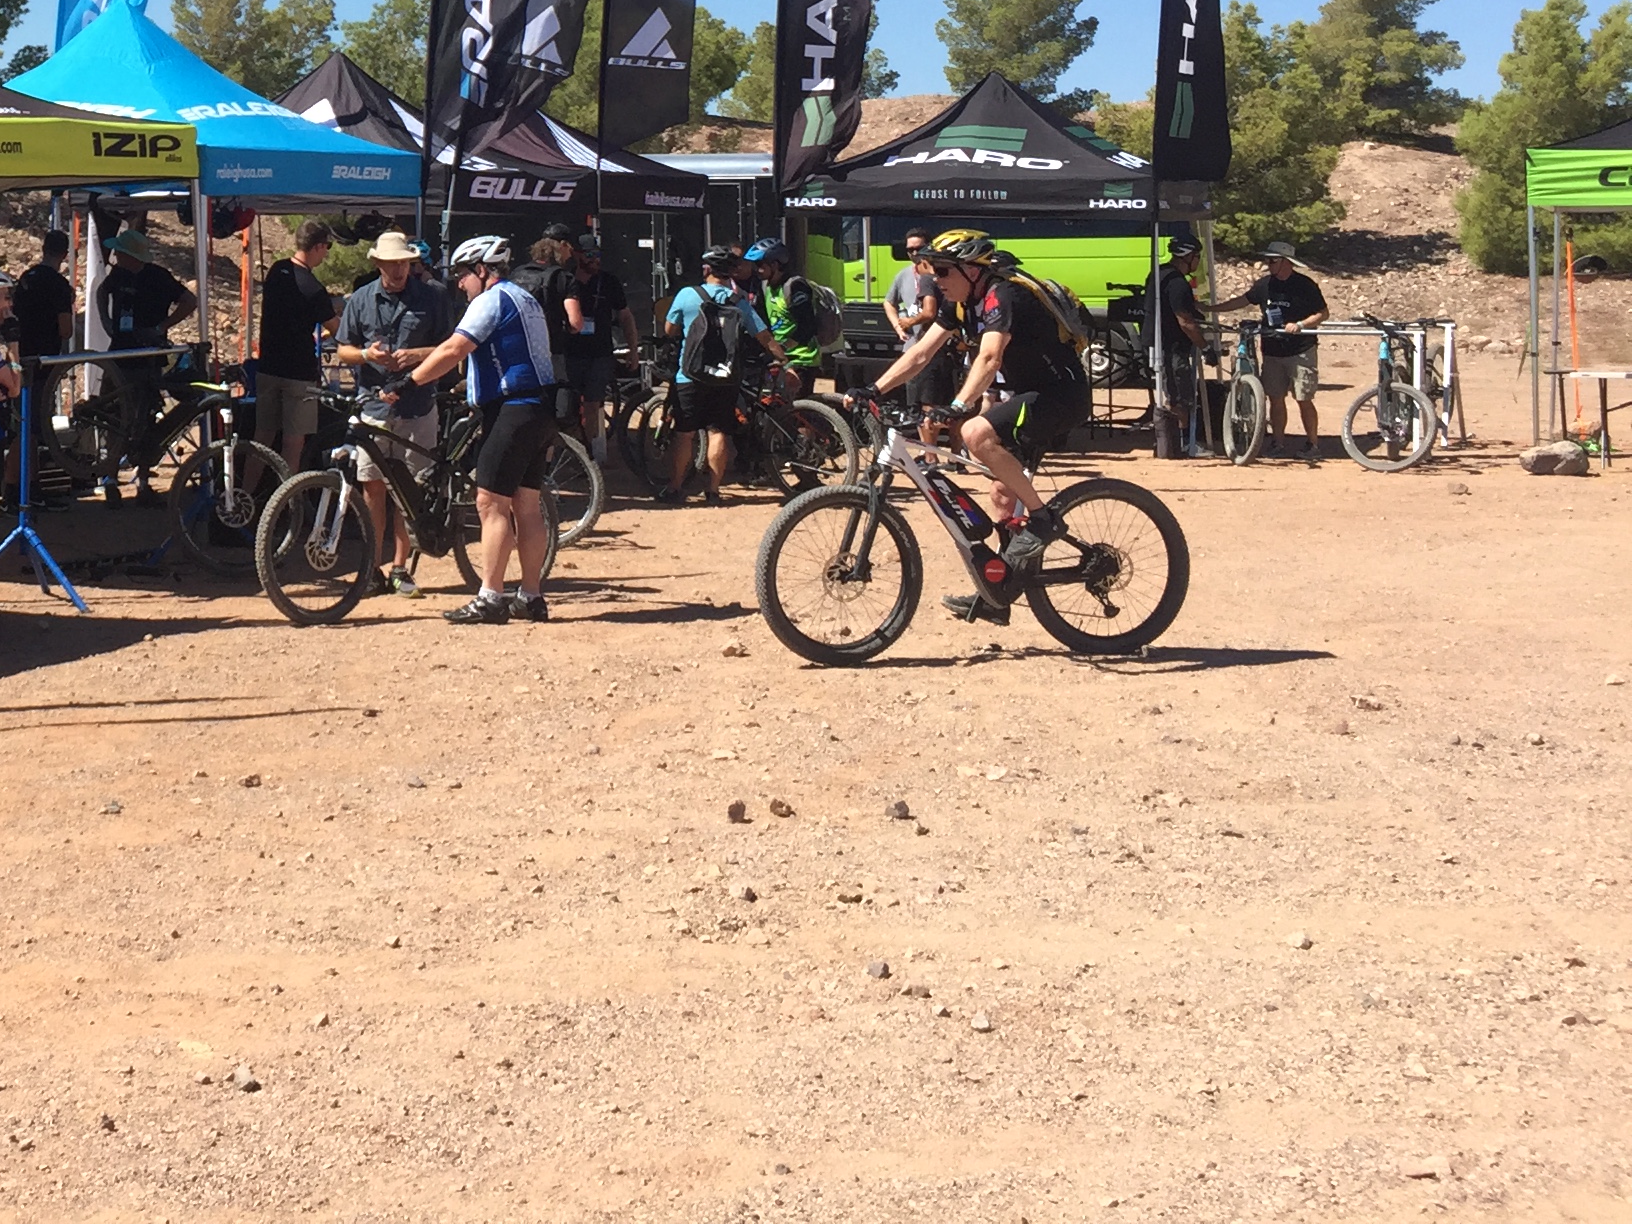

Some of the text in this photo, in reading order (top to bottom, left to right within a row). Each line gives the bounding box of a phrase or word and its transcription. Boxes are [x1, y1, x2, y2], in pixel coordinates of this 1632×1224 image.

[607, 56, 687, 70] BULLS
[883, 148, 1064, 171] HARO
[332, 164, 392, 181] RALEIGH
[468, 176, 578, 202] BULLS
[913, 188, 1009, 201] REFUSE TO FOLLOW
[785, 197, 838, 208] HARO
[1088, 198, 1148, 209] HARO
